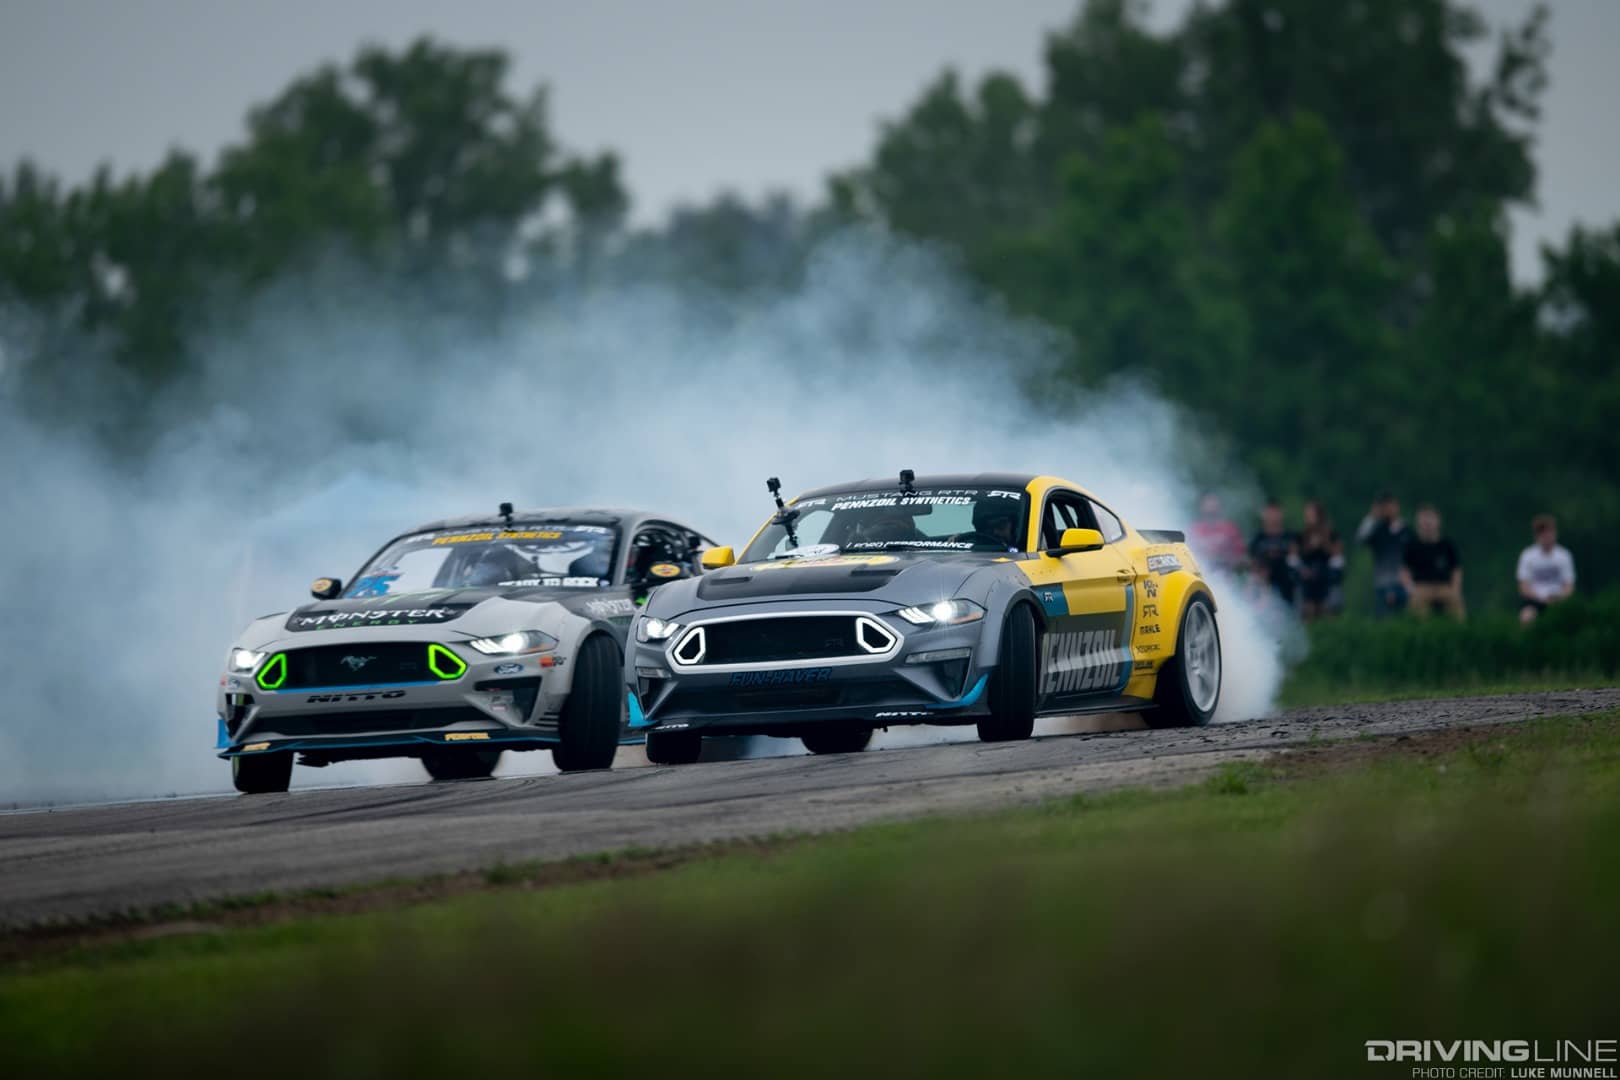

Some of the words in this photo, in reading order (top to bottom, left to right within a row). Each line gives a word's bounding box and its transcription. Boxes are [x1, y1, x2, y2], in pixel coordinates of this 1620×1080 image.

[832, 498, 897, 511] PENNZOIL
[900, 496, 971, 506] SYNTHETICS
[836, 490, 932, 502] MUSTANG
[300, 608, 446, 626] MONSTER
[316, 619, 418, 630] ENERGY
[1038, 629, 1121, 694] PENNZOIL
[730, 667, 833, 687] FUN-HAVER
[306, 690, 407, 703] NITTO
